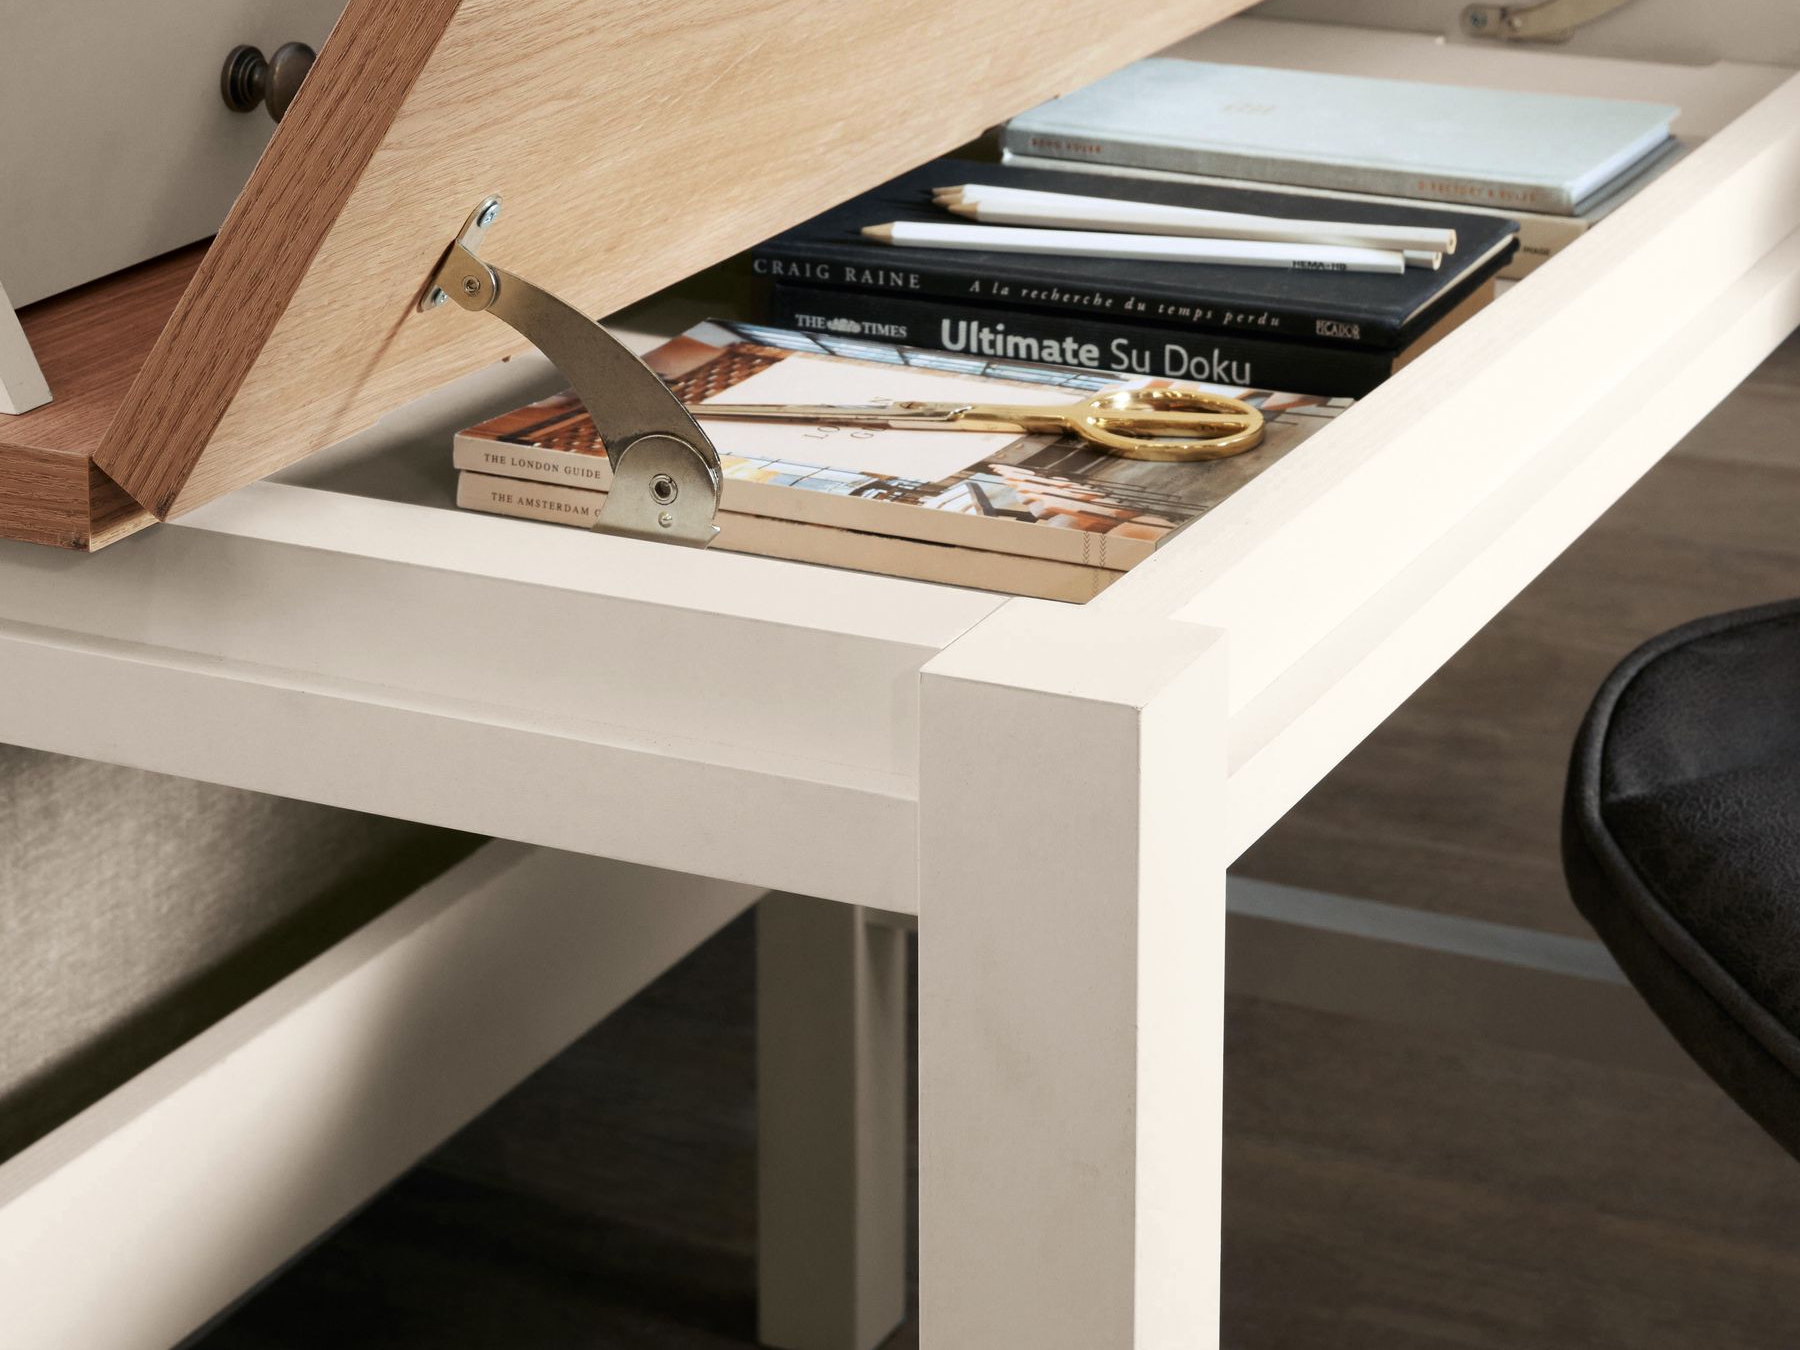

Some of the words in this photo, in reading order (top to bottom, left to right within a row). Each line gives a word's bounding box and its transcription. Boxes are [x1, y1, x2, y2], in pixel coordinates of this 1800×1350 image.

[753, 258, 831, 280] CRAIG
[845, 267, 921, 289] RAINE
[969, 280, 981, 293] A
[992, 282, 1009, 296] la
[1021, 286, 1114, 308] recherche
[1124, 296, 1147, 312] du
[1158, 303, 1214, 321] temps
[1223, 310, 1281, 328] perdu
[1316, 319, 1360, 340] PICADOR
[795, 314, 826, 330] THE
[861, 321, 907, 339] TIMES
[941, 317, 1099, 367] Ultimate
[1111, 338, 1150, 374] Su
[1164, 344, 1252, 386] Doku
[484, 453, 507, 465] THE
[511, 458, 559, 472] LONDON
[564, 466, 601, 479] GUIDE
[491, 492, 513, 504] THE
[517, 497, 590, 517] AMSTERDAM
